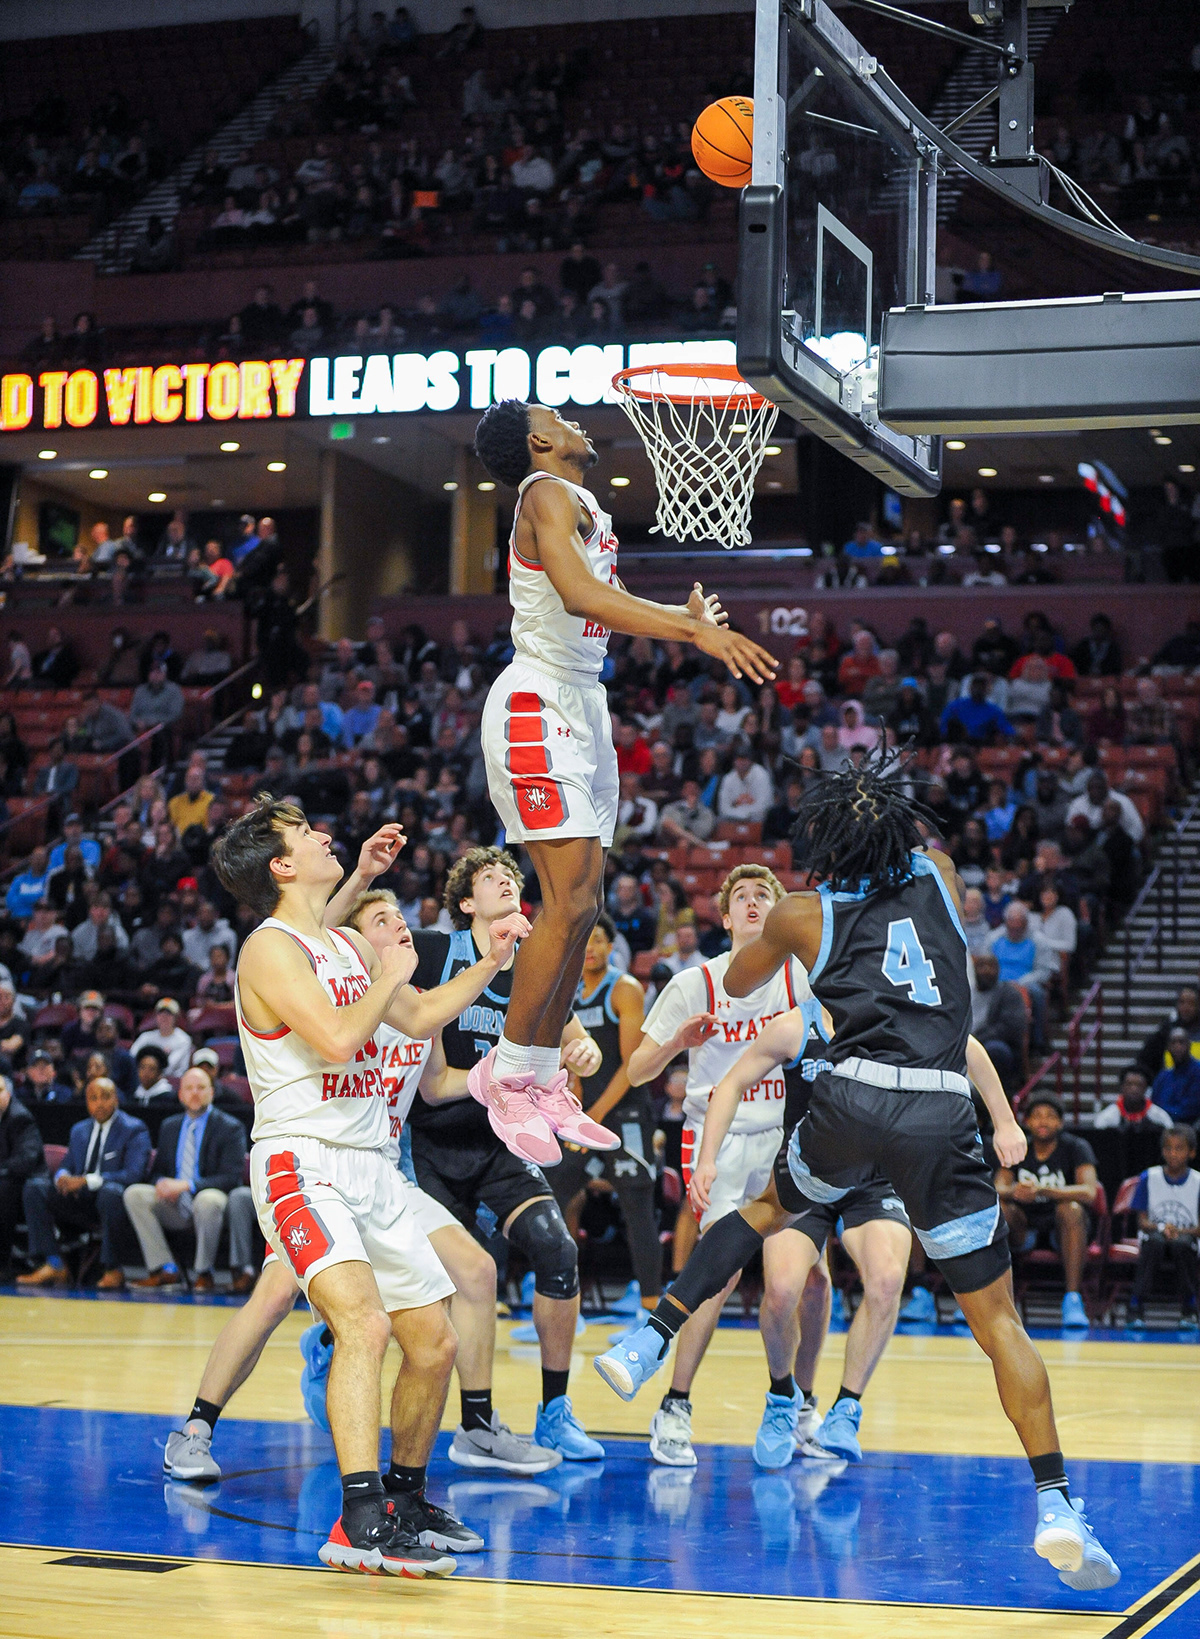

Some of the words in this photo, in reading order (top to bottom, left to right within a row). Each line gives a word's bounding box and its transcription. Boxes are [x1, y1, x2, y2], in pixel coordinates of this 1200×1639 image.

[39, 369, 98, 429] TO
[103, 358, 305, 425] VICTORY
[309, 350, 460, 416] LEADS
[466, 347, 531, 409] TO
[758, 606, 809, 636] 102
[881, 917, 942, 1007] 4
[722, 1011, 785, 1043] WA
